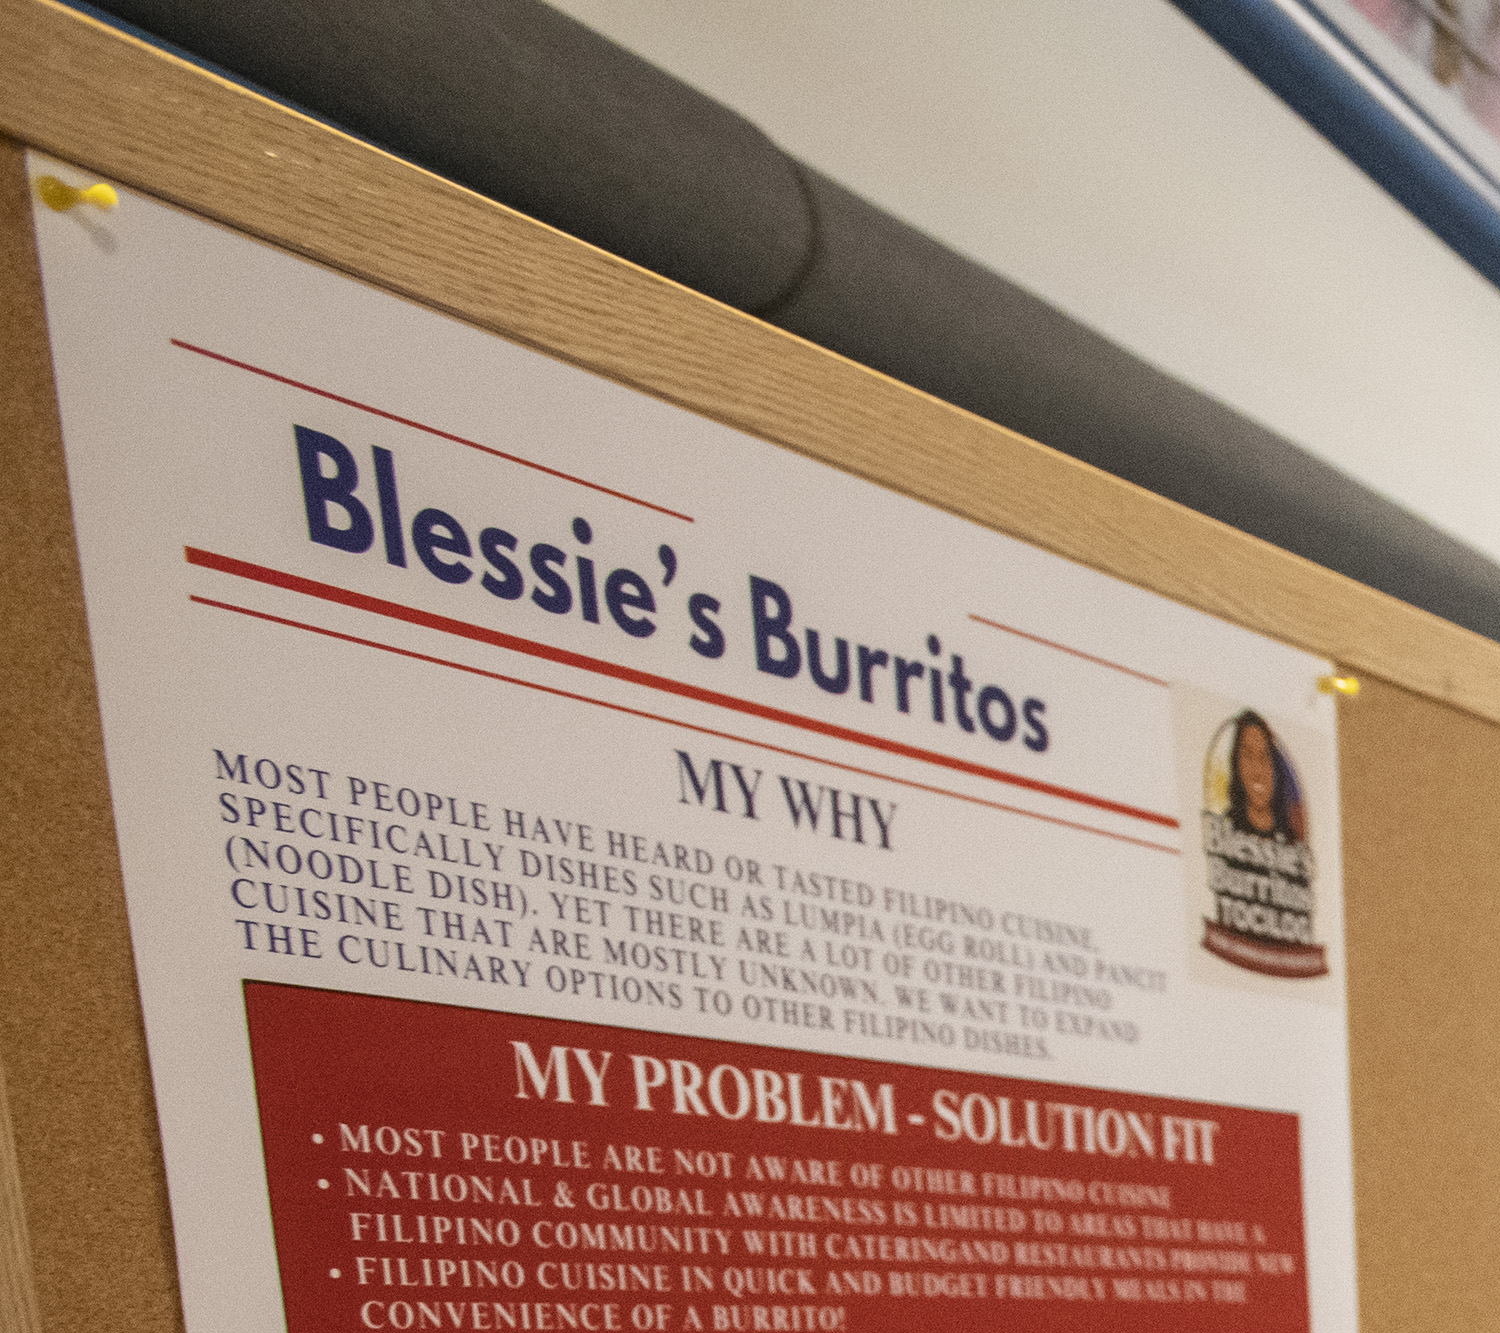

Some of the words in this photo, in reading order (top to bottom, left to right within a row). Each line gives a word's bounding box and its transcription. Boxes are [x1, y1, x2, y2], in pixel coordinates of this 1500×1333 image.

[293, 423, 726, 660] Blessie's
[749, 574, 1050, 753] Burritos
[213, 748, 330, 800] MOST
[347, 776, 490, 832] PEOPLE
[503, 808, 594, 853] HAVE
[606, 829, 714, 875] HEARD
[724, 855, 763, 886] OR
[772, 864, 875, 908] TASTED
[883, 886, 995, 931] FILIPINO
[676, 750, 762, 820] MY
[778, 775, 896, 850] WHY
[218, 791, 500, 872] SPECIFICALLY
[519, 848, 638, 897] DISHES
[648, 874, 729, 914] SUCH
[743, 894, 774, 921] AS
[782, 899, 885, 943] LUMPIA
[892, 923, 955, 956] (EGG
[1042, 952, 1089, 979] AND
[224, 836, 414, 894] (NOODLE
[428, 869, 538, 916] DISH).
[549, 891, 610, 928] YET
[623, 904, 724, 946] THERE
[738, 927, 789, 958] ARE
[802, 938, 817, 963] A
[825, 940, 873, 972] LOT
[882, 951, 914, 979] OF
[922, 959, 1006, 994] OTHER
[1013, 973, 1112, 1011] FILIPINO
[230, 877, 403, 932] CUISINE
[416, 906, 513, 948] THAT
[528, 927, 590, 961] ARE
[602, 937, 723, 981] MOSTLY
[894, 985, 930, 1013] WE
[938, 992, 1008, 1024] WANT
[1018, 1003, 1049, 1030] TO
[235, 918, 322, 960] THE
[337, 933, 528, 988] CULINARY
[544, 964, 683, 1010] OPTIONS
[693, 986, 733, 1017] TO
[741, 994, 835, 1030] OTHER
[843, 1008, 956, 1046] FILIPINO
[339, 1123, 445, 1158] MOST
[460, 1132, 590, 1169] PEOPLE
[605, 1144, 663, 1174] ARE
[673, 1149, 733, 1179] NOT
[748, 1156, 841, 1186] AWARE
[849, 1163, 882, 1189] OF
[891, 1166, 976, 1195] OTHER
[982, 1172, 1086, 1201] FILIPINO
[1087, 1181, 1171, 1209] CUISINE
[511, 1041, 612, 1107] MY
[631, 1055, 898, 1135] PROBLEM
[932, 1089, 1155, 1157] SOLUTION
[1161, 1115, 1219, 1166] FIT
[344, 1167, 541, 1207] NATIONAL
[553, 1181, 576, 1209] &
[586, 1183, 712, 1216] GLOBAL
[726, 1192, 887, 1225] AWARENESS
[893, 1201, 918, 1226] IS
[924, 1203, 1027, 1232] LIMITED
[1032, 1209, 1064, 1234] TO
[350, 1212, 521, 1246] FILIPINO
[531, 1221, 729, 1255] COMMUNITY
[742, 1230, 817, 1258] WITH
[356, 1256, 526, 1288] FILIPINO
[536, 1262, 670, 1292] CUISINE
[681, 1266, 714, 1292] IN
[723, 1267, 816, 1298] QUICK
[827, 1270, 883, 1295] AND
[888, 1271, 987, 1298] BUDGET
[994, 1274, 1105, 1300] FRIENDLY
[360, 1300, 621, 1331] CONVENIENCE
[631, 1304, 671, 1330] OF
[686, 1305, 703, 1330] A
[712, 1305, 845, 1331] BURRITO!
